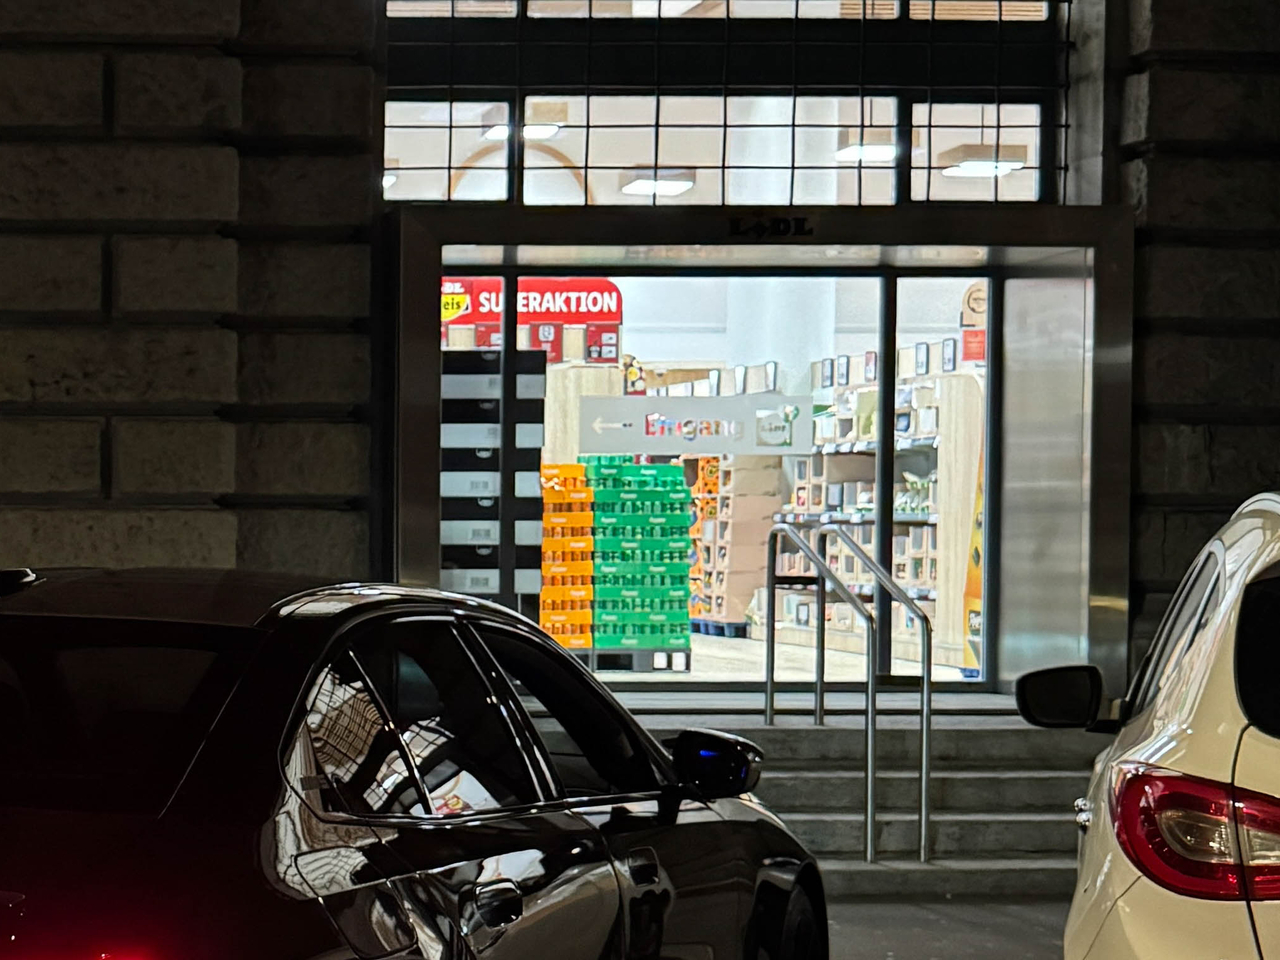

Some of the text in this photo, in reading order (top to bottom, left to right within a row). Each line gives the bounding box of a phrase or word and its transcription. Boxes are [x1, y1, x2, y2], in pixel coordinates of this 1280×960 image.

[728, 210, 814, 237] LIDL
[443, 297, 461, 310] eis
[478, 291, 618, 313] SUERAKTION
[645, 413, 745, 441] Eingang
